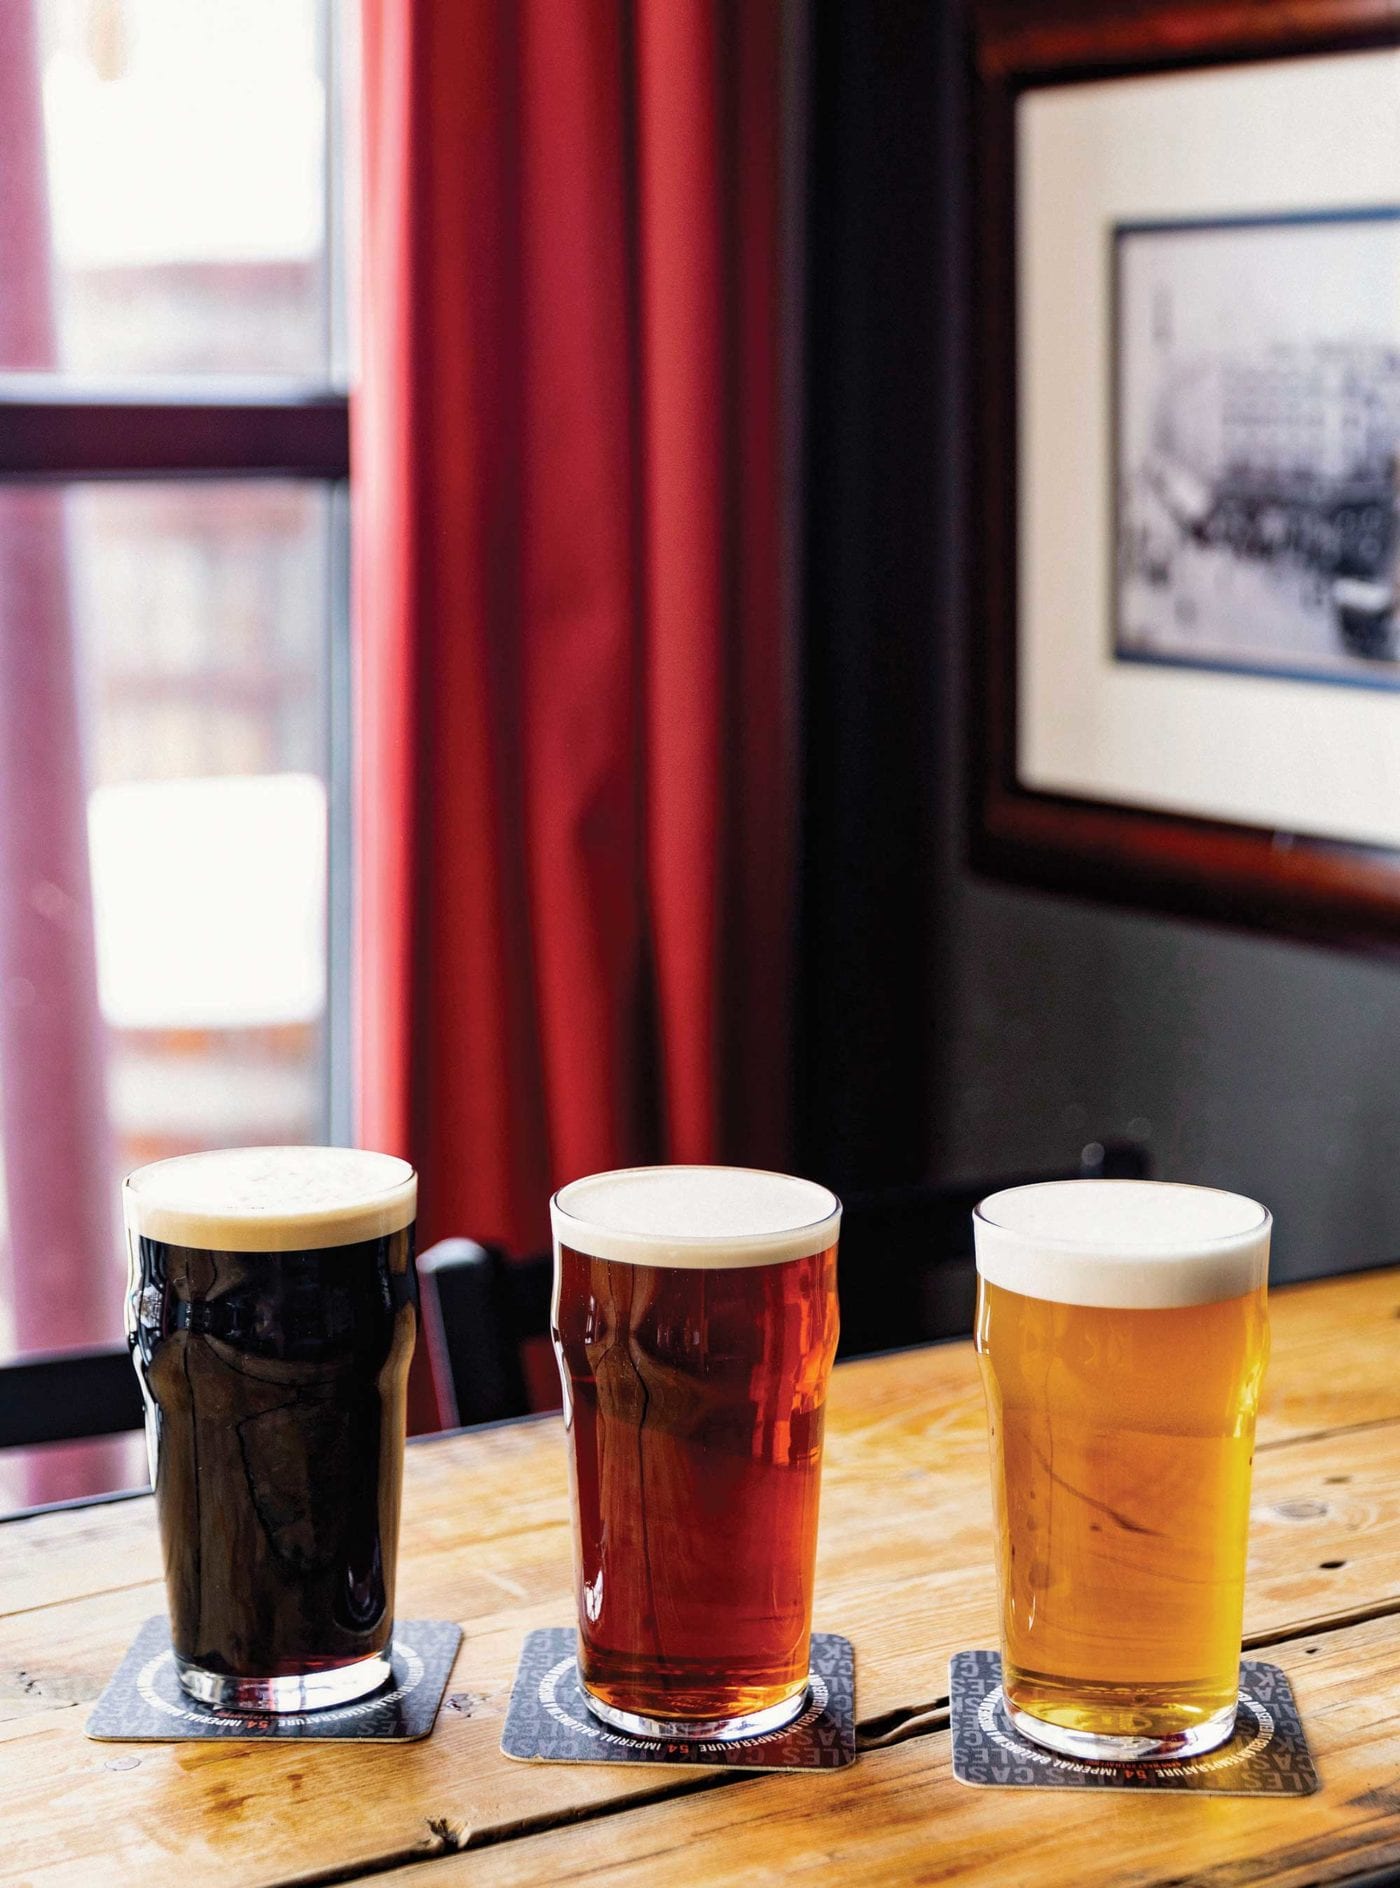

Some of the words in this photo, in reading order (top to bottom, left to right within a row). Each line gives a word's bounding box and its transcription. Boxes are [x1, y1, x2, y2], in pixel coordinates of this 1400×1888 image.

[184, 1712, 242, 1726] IMPERIAL
[247, 1720, 270, 1728] 54
[555, 1712, 600, 1736] GALLONS
[599, 1733, 662, 1750] IMPERIAL
[667, 1744, 689, 1754] 54
[699, 1729, 789, 1752] TEMPERATURE
[1052, 1758, 1117, 1776] IMPERIAL
[1155, 1754, 1243, 1777] TEMPERATURE
[1124, 1770, 1148, 1780] 54
